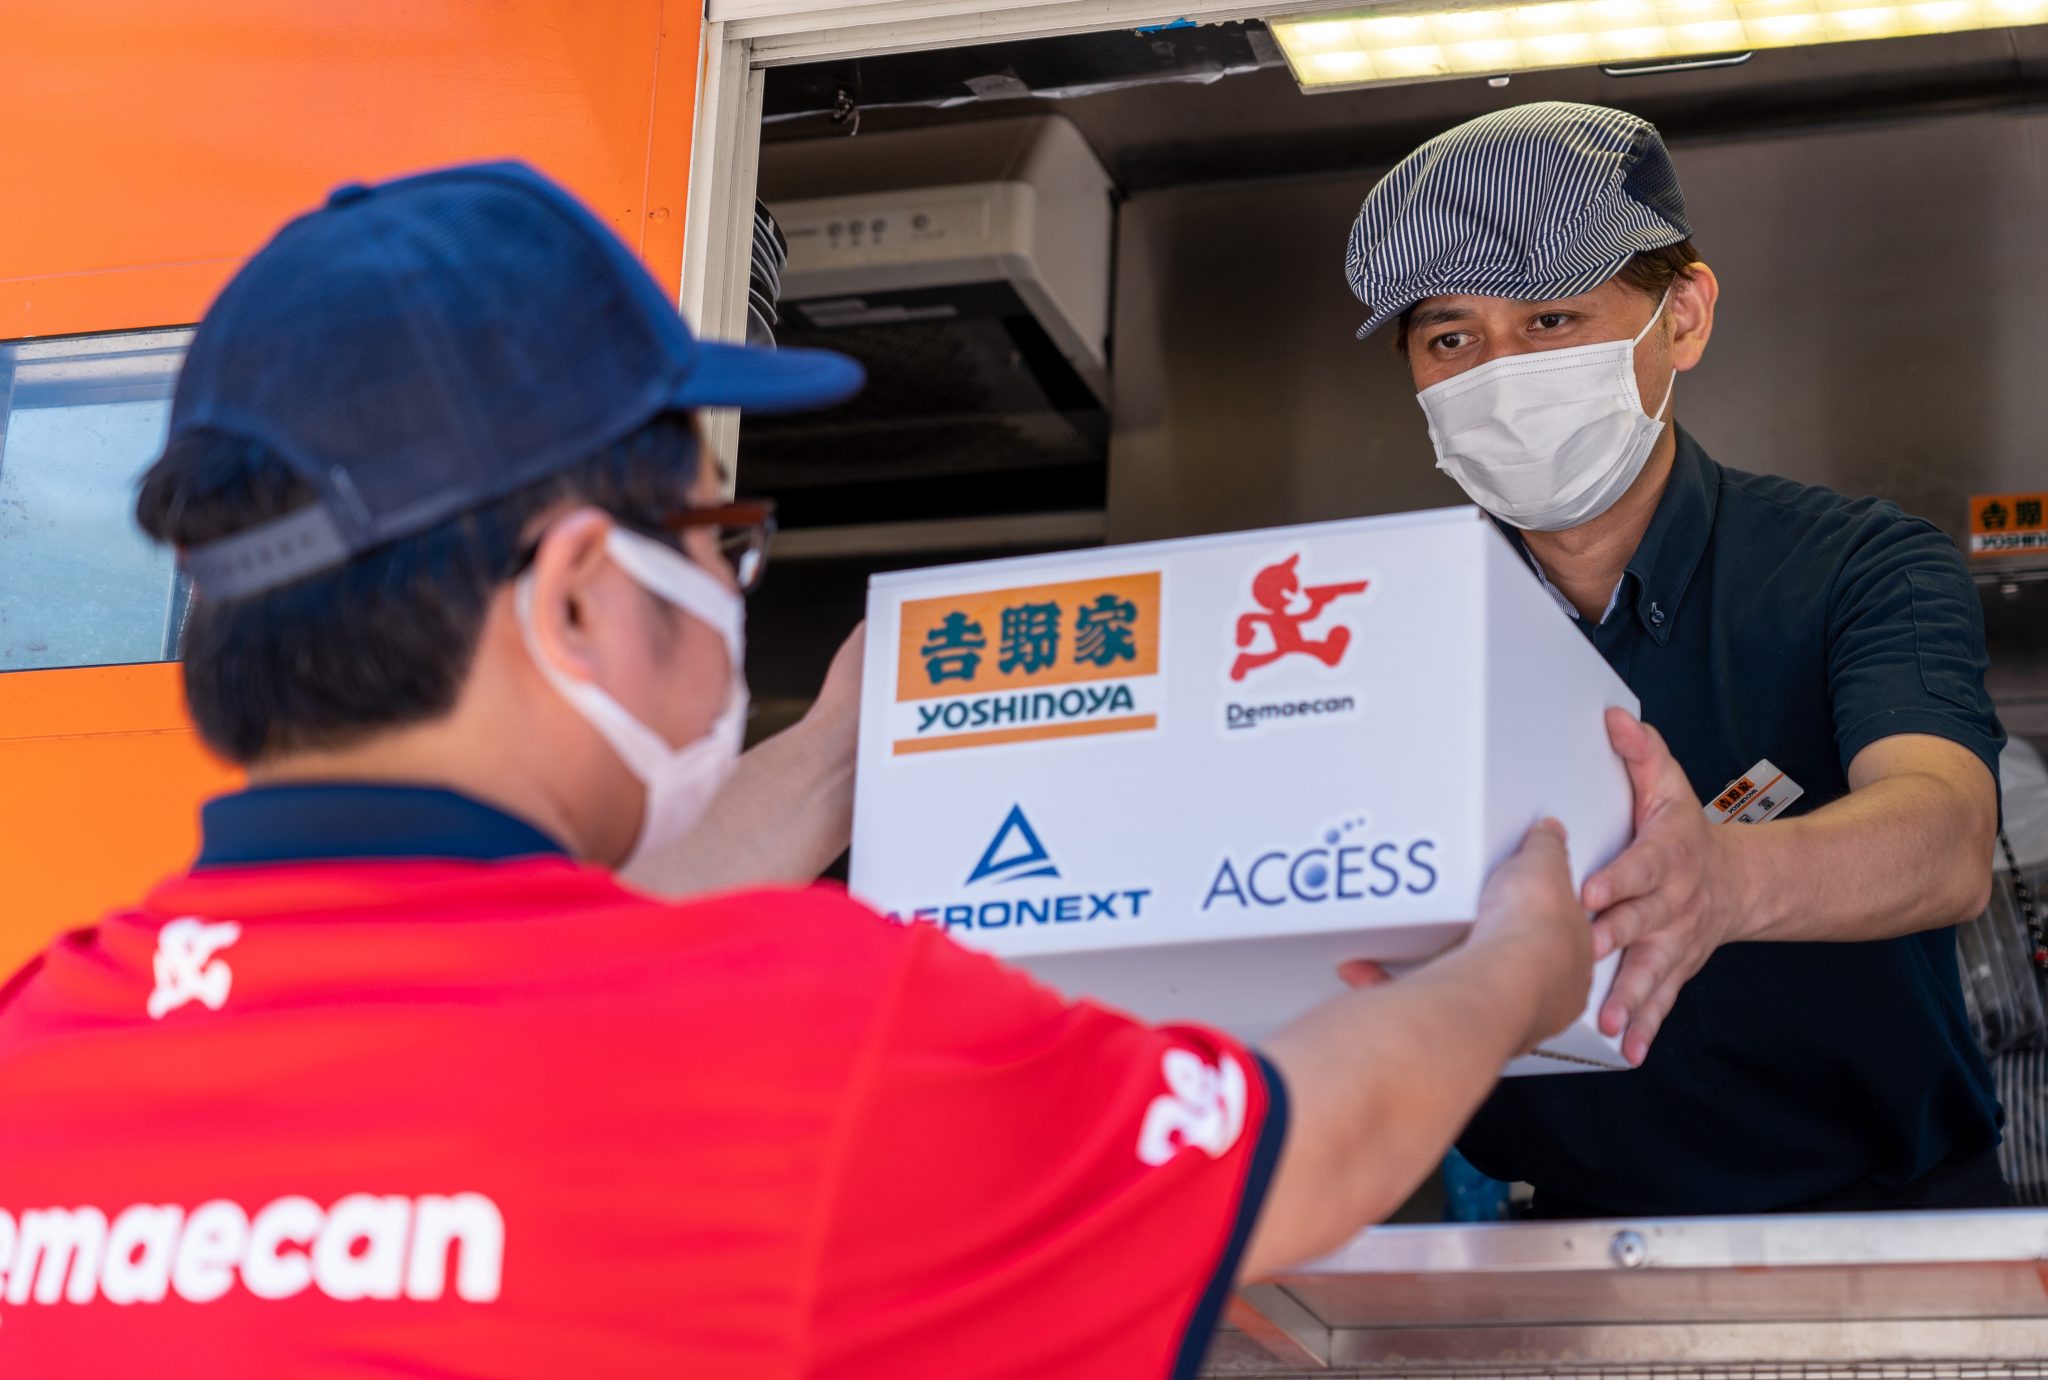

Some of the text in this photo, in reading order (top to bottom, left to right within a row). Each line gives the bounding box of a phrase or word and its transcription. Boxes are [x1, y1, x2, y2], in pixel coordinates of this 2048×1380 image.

[917, 684, 1135, 733] YOSHINOYA
[1226, 695, 1355, 728] Demaecan
[1201, 839, 1438, 912] ACCESS
[0, 1191, 506, 1306] maecan
